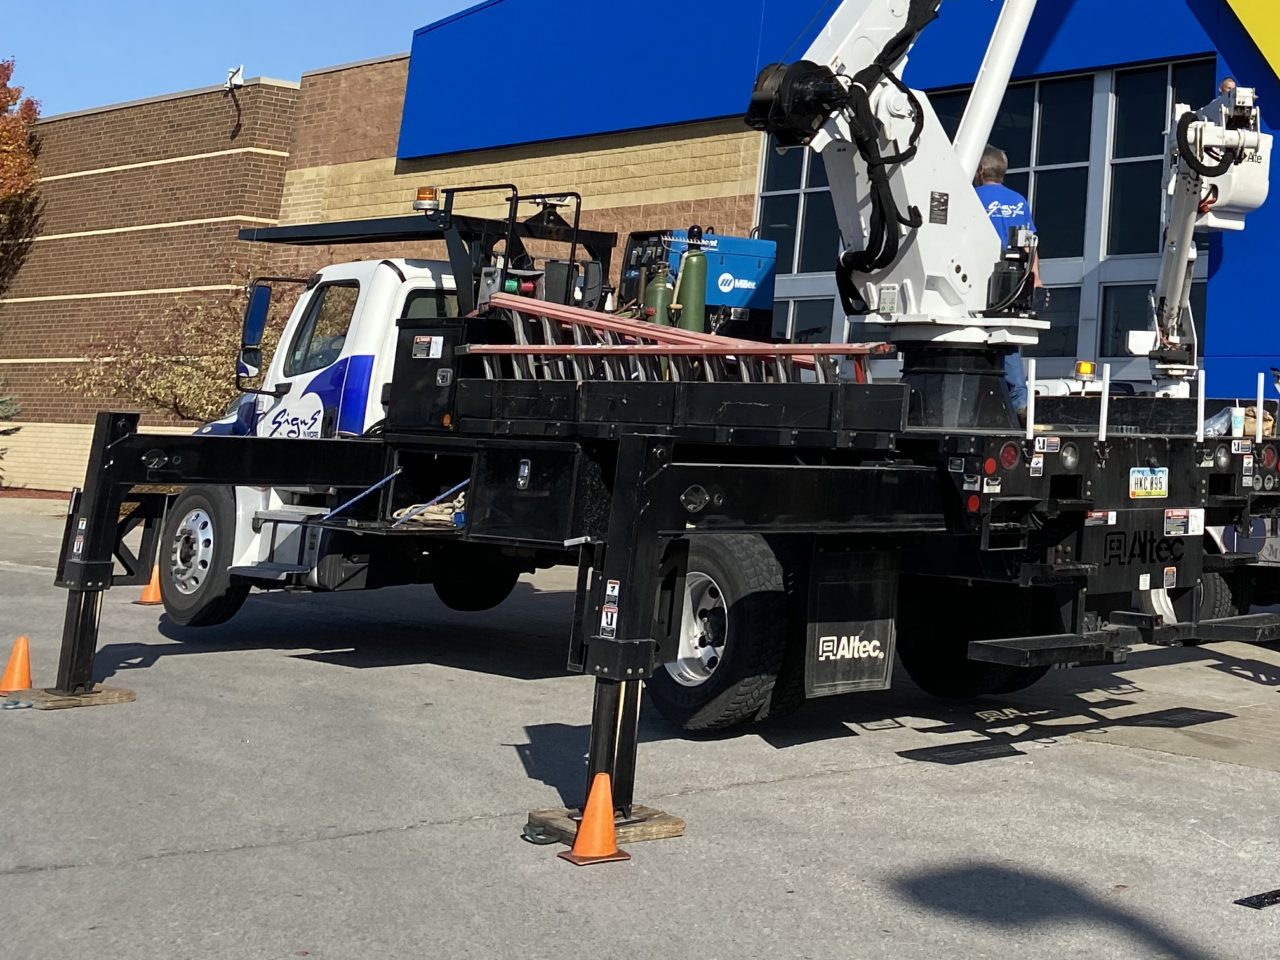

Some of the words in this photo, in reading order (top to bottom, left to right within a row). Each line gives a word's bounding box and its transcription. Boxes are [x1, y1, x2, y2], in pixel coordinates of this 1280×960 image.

[269, 408, 321, 439] Signs
[1134, 476, 1148, 491] HKC
[1127, 530, 1185, 565] Altec
